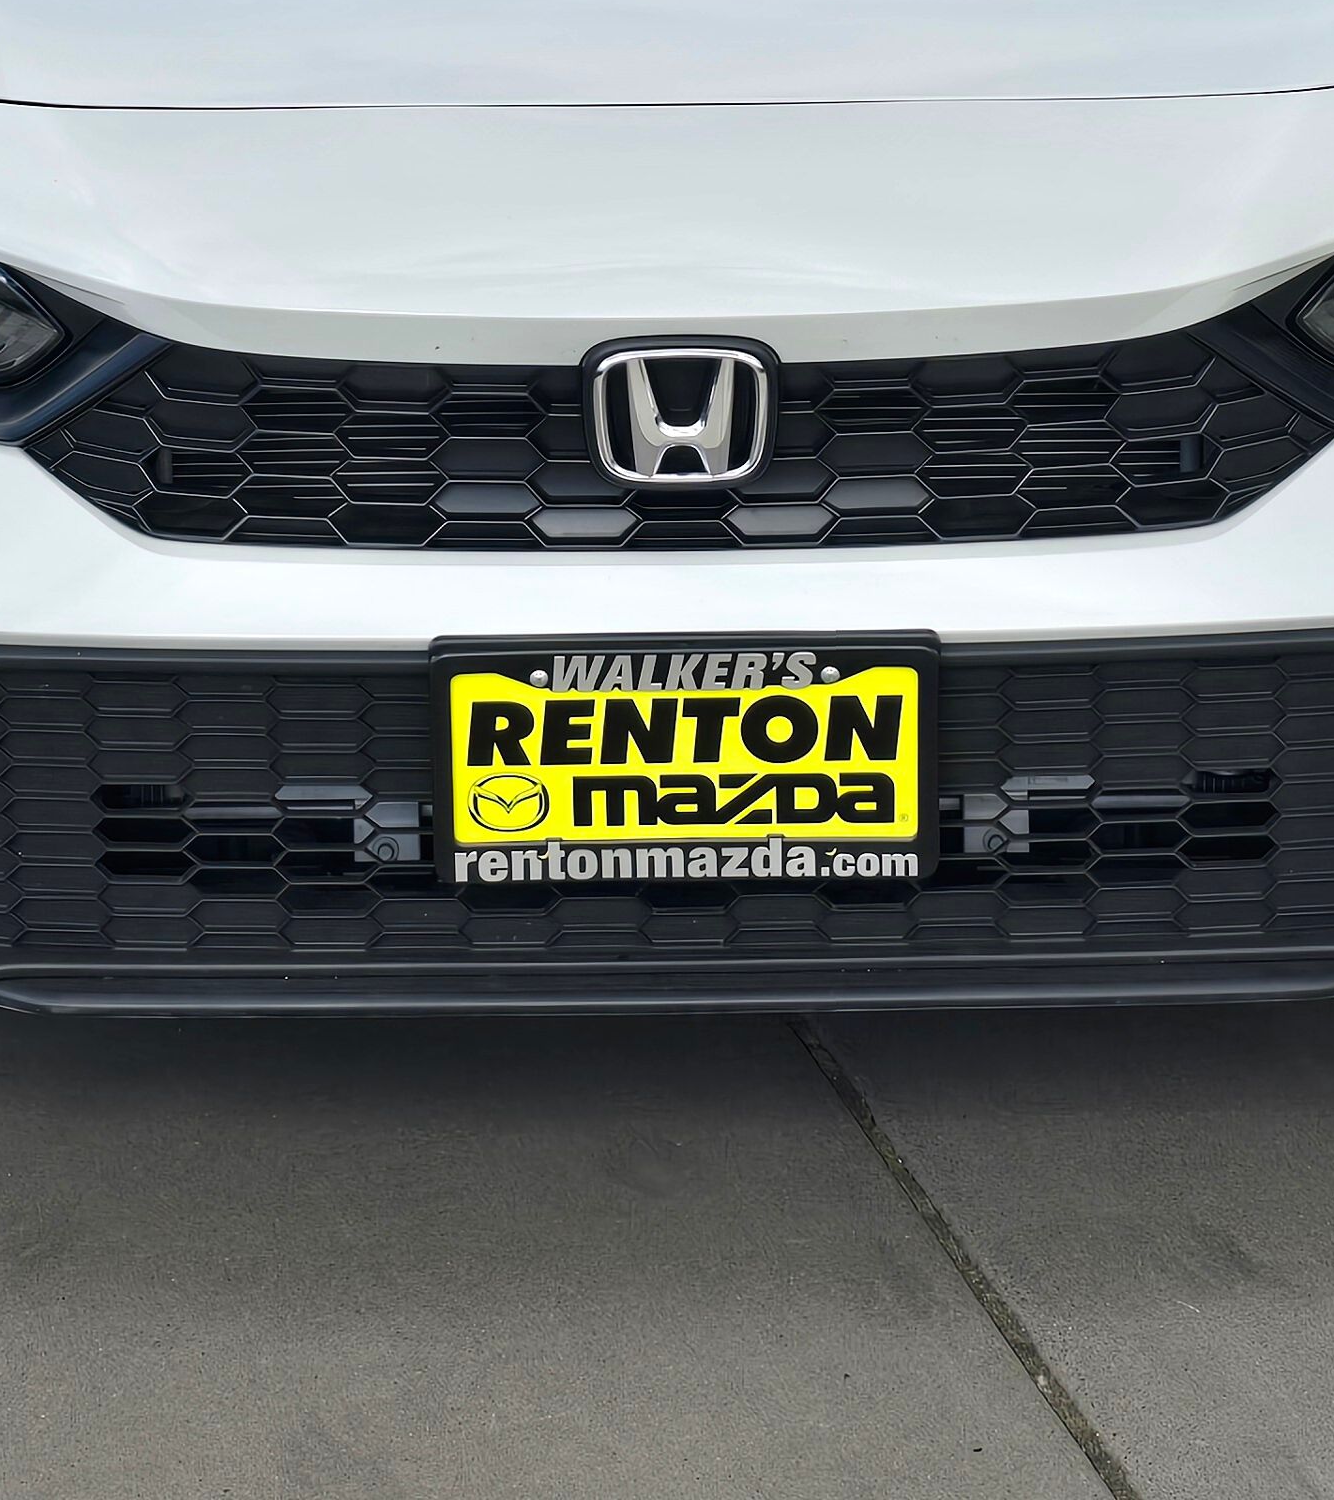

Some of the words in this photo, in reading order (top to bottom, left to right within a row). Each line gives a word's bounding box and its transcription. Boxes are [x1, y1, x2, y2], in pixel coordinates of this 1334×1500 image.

[549, 651, 817, 692] WALKER'S
[467, 695, 904, 766] RENTON
[454, 838, 919, 882] rentonmazda.com
